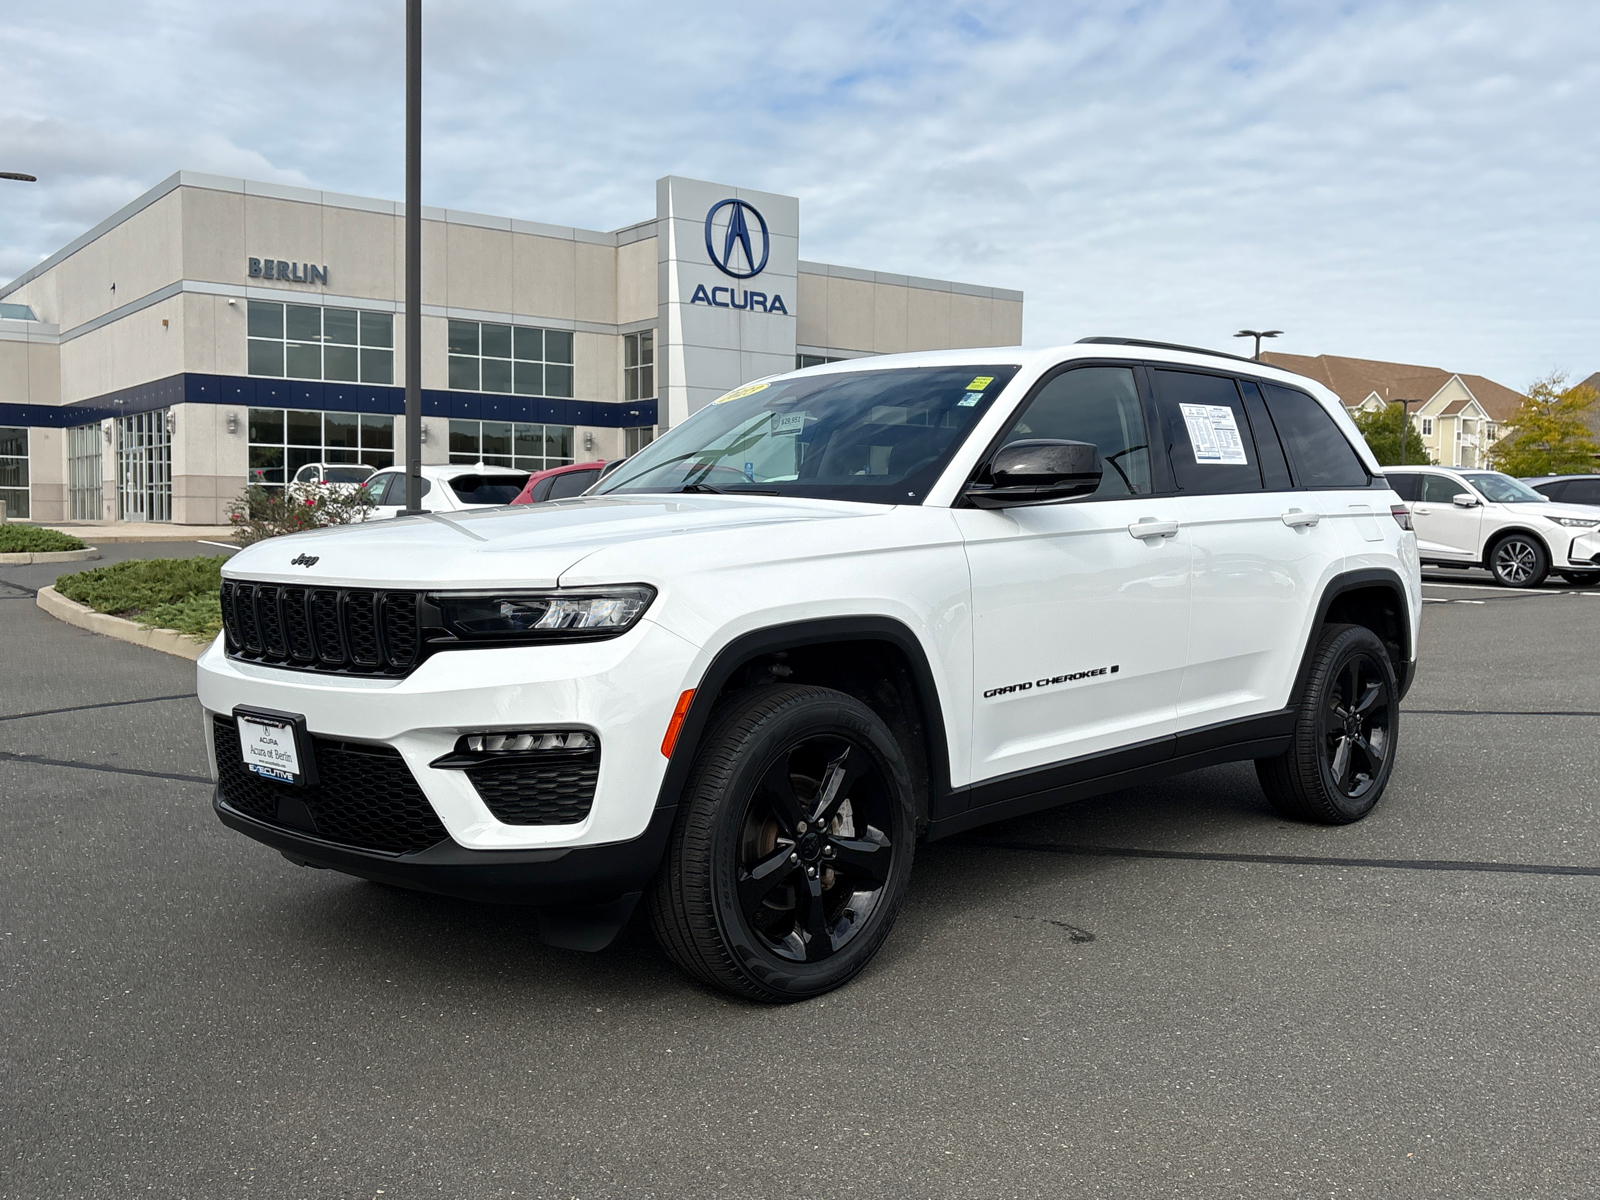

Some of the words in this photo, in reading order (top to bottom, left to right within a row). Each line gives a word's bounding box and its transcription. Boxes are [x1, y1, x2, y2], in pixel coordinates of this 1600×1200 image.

[248, 257, 328, 286] BERLIN
[690, 284, 788, 315] ACURA
[290, 552, 320, 569] Jeep
[983, 681, 1033, 699] GRAND
[1036, 667, 1108, 687] CHEROKEE
[259, 737, 279, 746] ACURA
[250, 744, 267, 758] Acura
[267, 748, 274, 759] of
[275, 749, 293, 763] Berlin
[248, 763, 294, 780] EXECUTIVE
